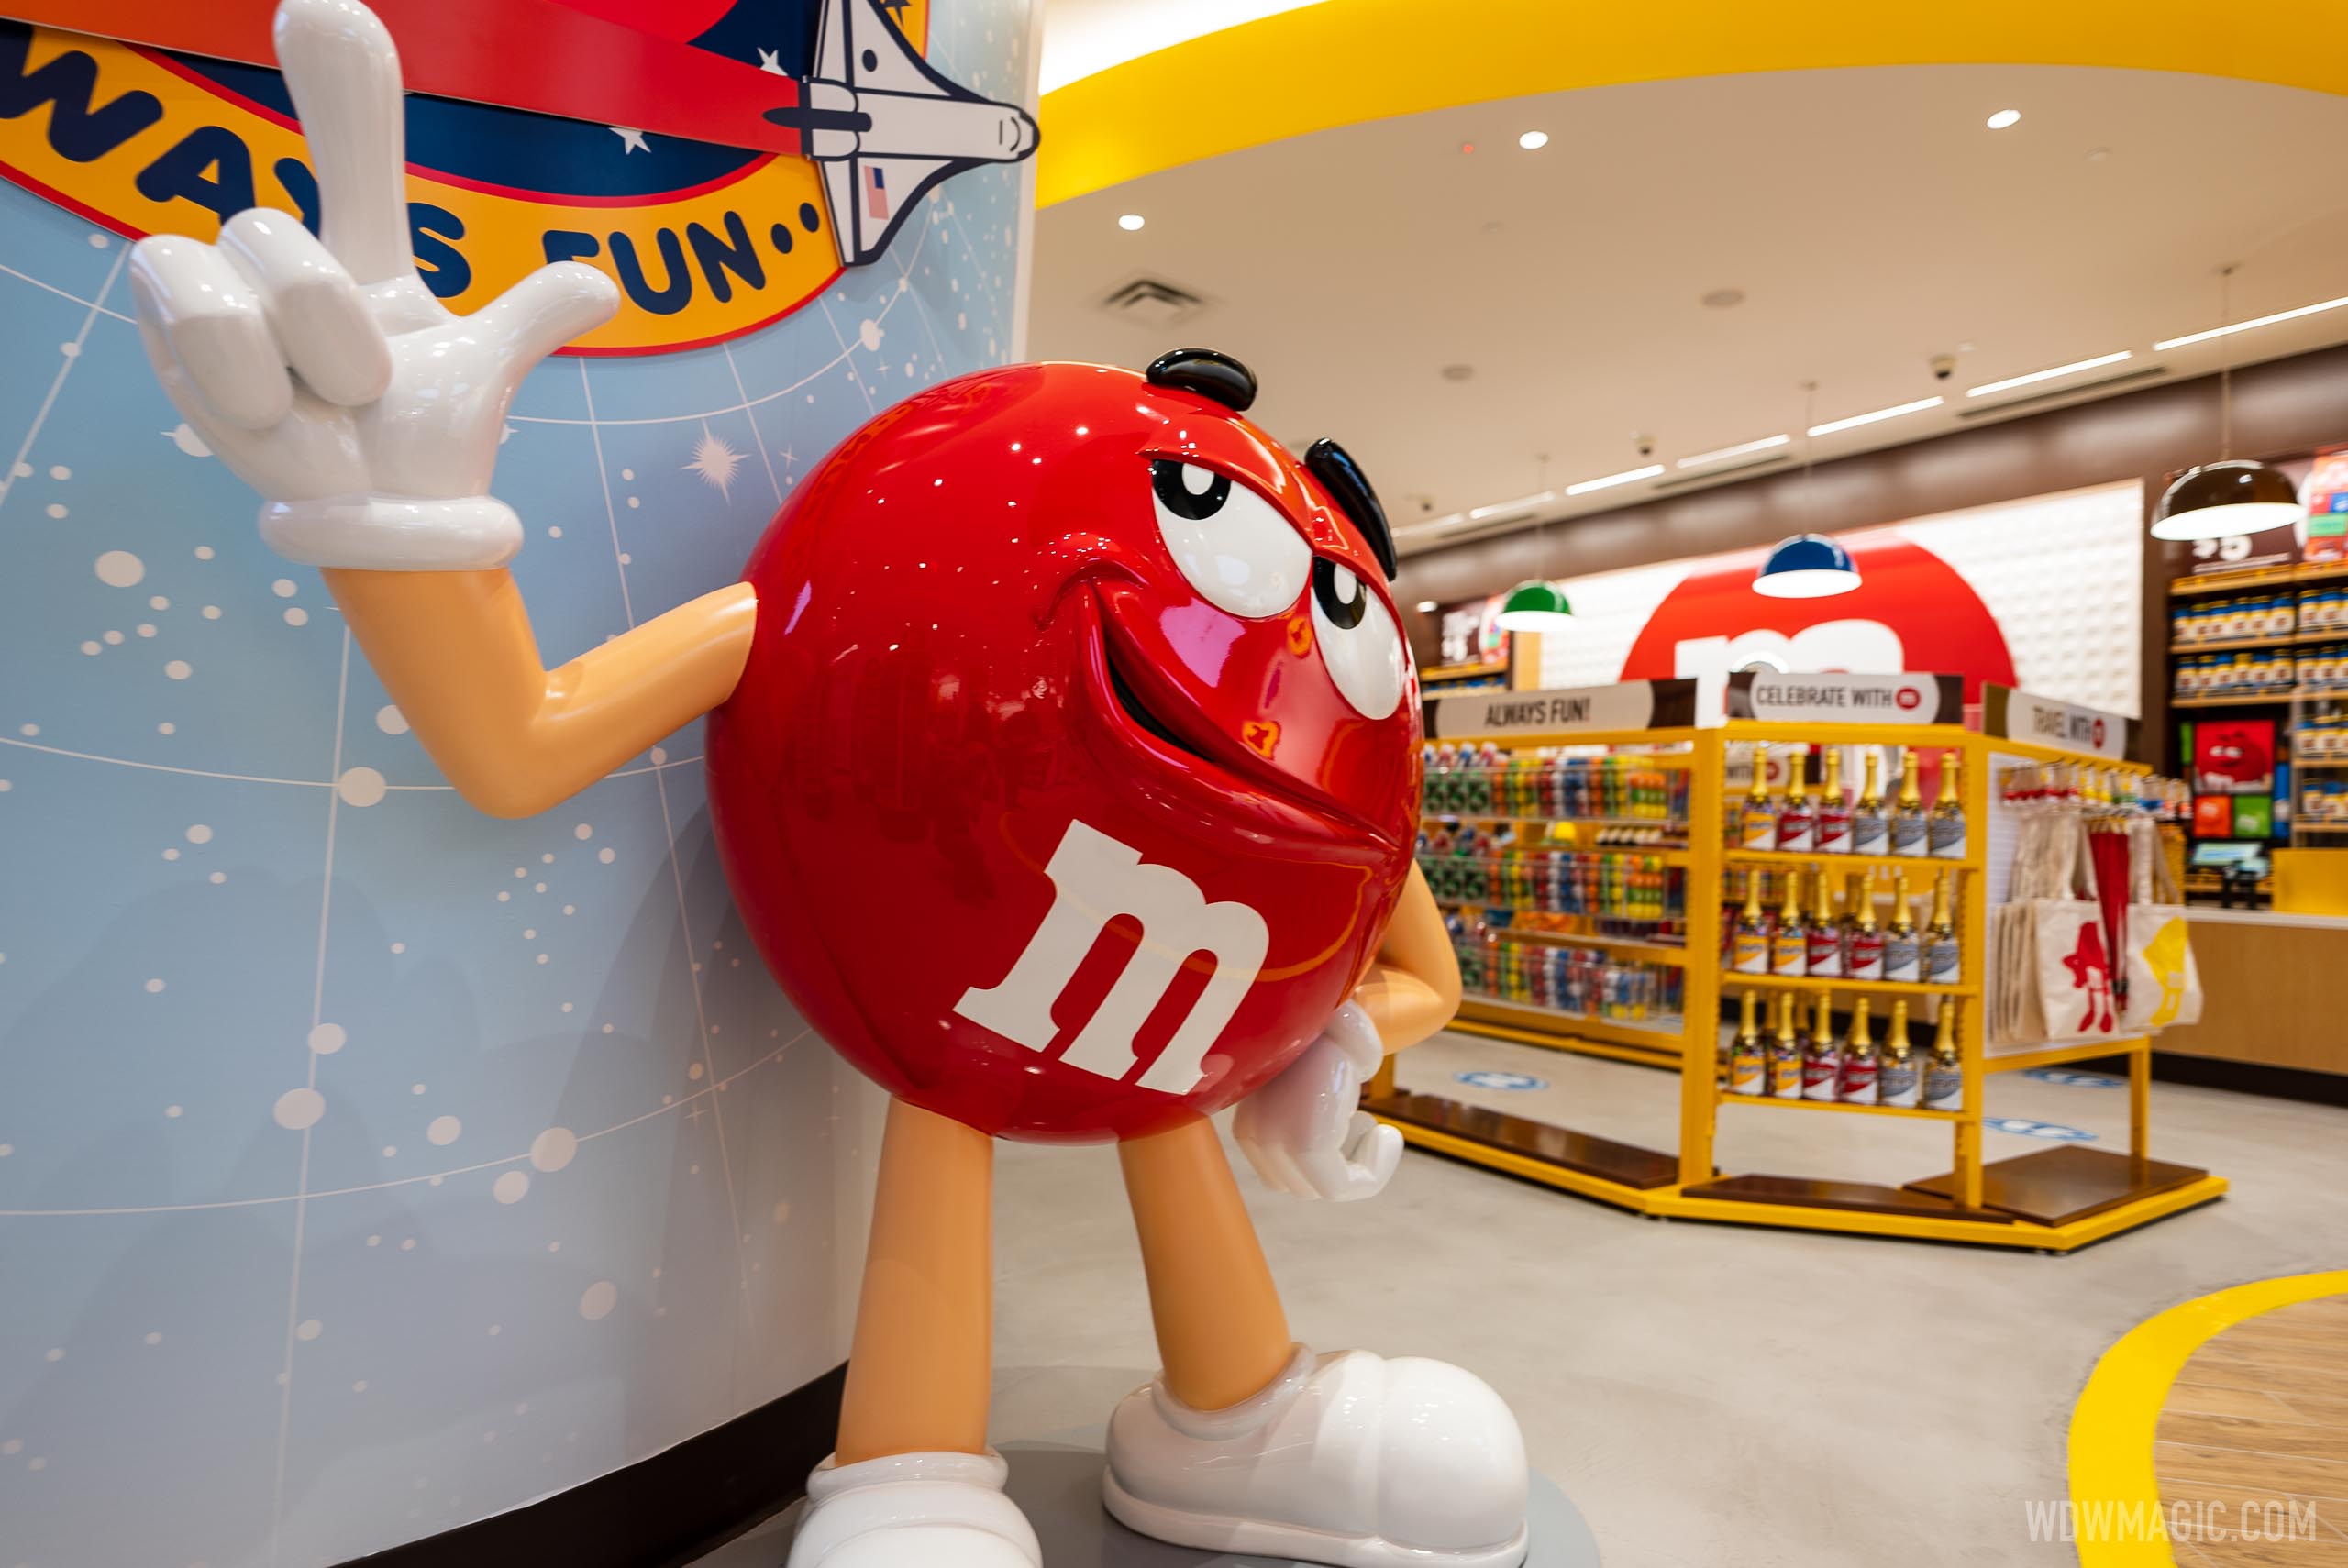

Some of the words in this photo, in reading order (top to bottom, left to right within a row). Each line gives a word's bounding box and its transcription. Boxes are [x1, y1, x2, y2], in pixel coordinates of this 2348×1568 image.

[1485, 700, 1545, 727] ALWAYS
[1550, 696, 1591, 723] FUN!
[1757, 685, 1845, 708] CELEBRATE
[1853, 689, 1892, 707] WITH
[952, 818, 1269, 1096] m
